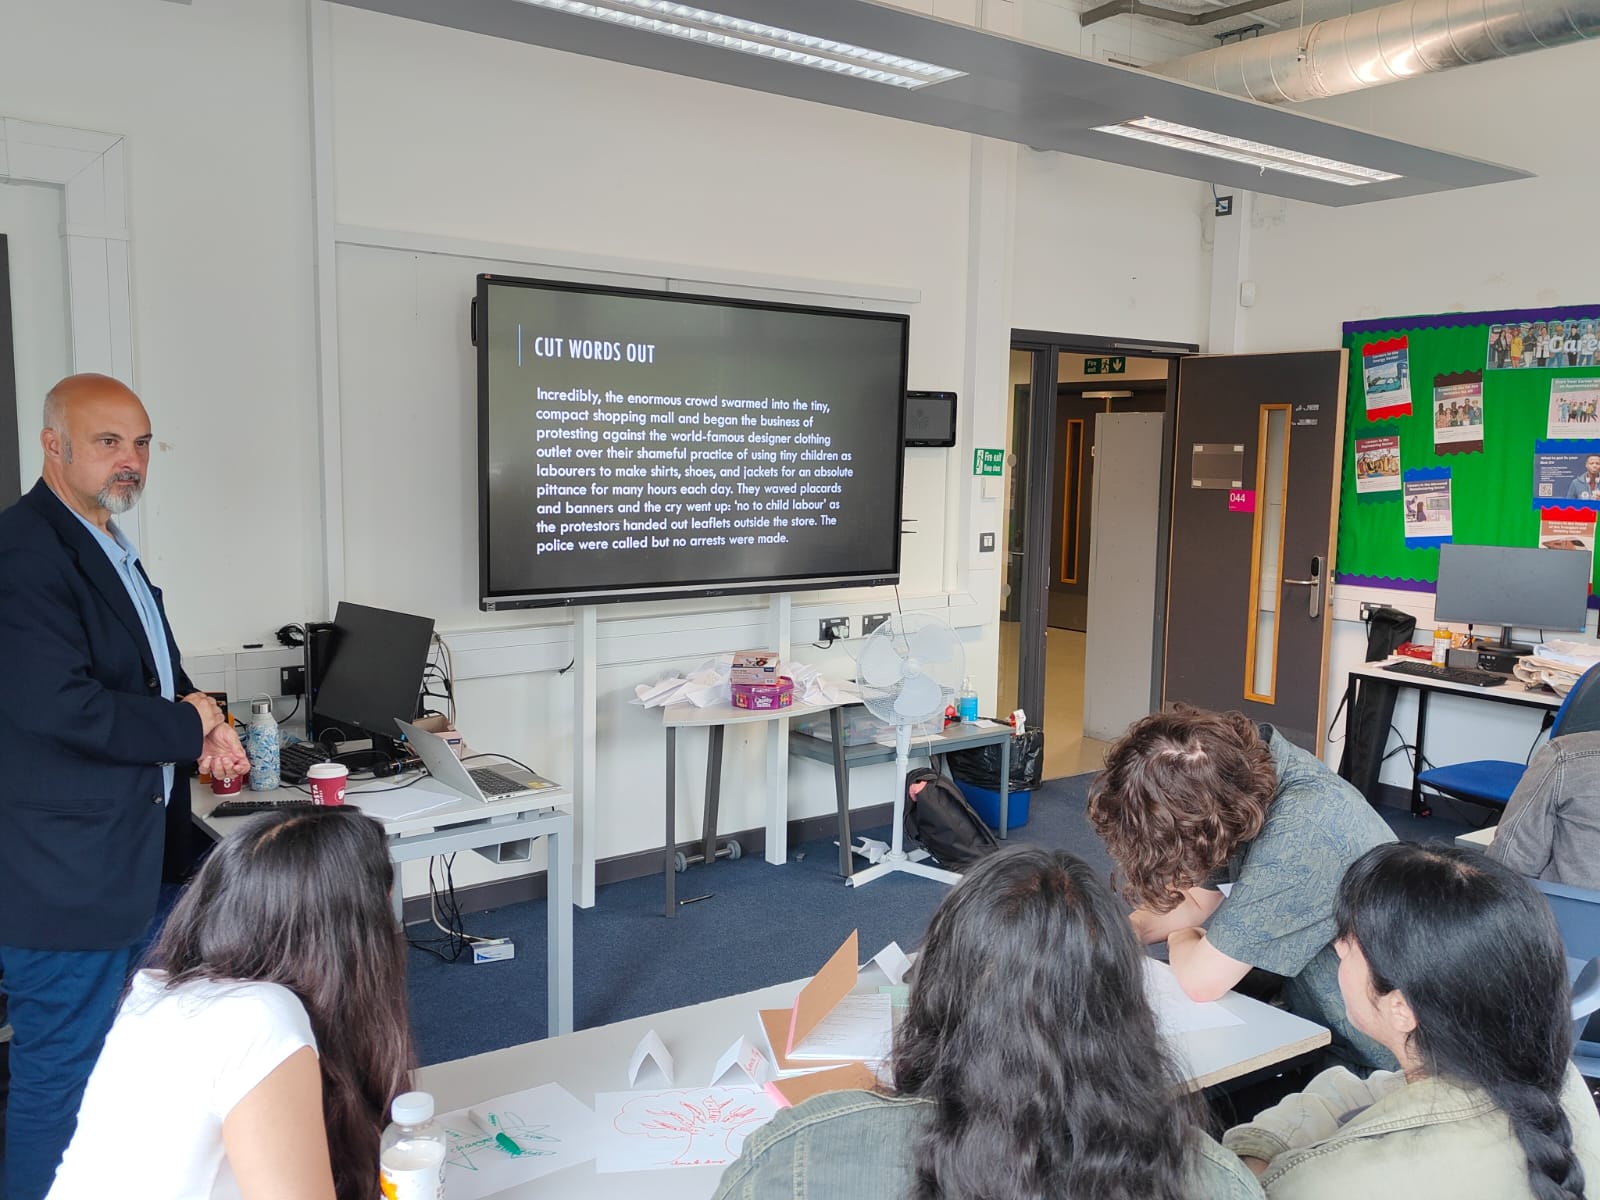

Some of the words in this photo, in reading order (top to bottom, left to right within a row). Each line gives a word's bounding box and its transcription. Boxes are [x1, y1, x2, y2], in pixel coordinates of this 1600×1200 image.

[535, 337, 564, 358] CUT
[568, 339, 621, 361] WORDS
[626, 343, 655, 363] OUT
[537, 387, 602, 406] Incredibly,
[605, 390, 624, 403] the
[627, 395, 682, 406] enormous
[684, 395, 718, 409] crowd
[721, 397, 768, 409] swarmed
[771, 398, 790, 410] into
[792, 398, 808, 410] the
[811, 400, 830, 414] tiny,
[536, 410, 590, 423] compact
[593, 408, 647, 426] shopping
[650, 411, 675, 424] mall
[677, 411, 700, 424] and
[703, 412, 738, 428] began
[740, 413, 758, 426] the
[760, 414, 800, 427] business
[802, 415, 814, 428] of
[536, 427, 599, 443] protesting
[602, 428, 646, 443] against
[649, 428, 667, 441] the
[670, 429, 745, 444] world-famous
[747, 431, 792, 446] designer
[793, 432, 831, 447] clothing
[536, 444, 573, 458] outlet
[575, 449, 603, 458] over
[606, 445, 634, 459] their
[637, 446, 687, 460] shameful
[690, 448, 734, 463] practice
[736, 448, 749, 460] of
[751, 449, 777, 463] using
[779, 449, 798, 464] tiny
[800, 448, 839, 461] children
[840, 453, 852, 461] as
[984, 451, 993, 461] Fire
[536, 463, 596, 477] labourers
[599, 466, 612, 477] to
[615, 464, 647, 477] make
[650, 464, 682, 480] shirts,
[684, 464, 717, 480] shoes,
[719, 465, 741, 477] and
[743, 465, 778, 480] jackets
[781, 465, 796, 477] for
[798, 468, 811, 478] an
[813, 465, 854, 478] absolute
[536, 483, 587, 499] pittance
[590, 482, 609, 496] for
[612, 486, 644, 498] many
[647, 482, 677, 495] hours
[680, 482, 707, 495] each
[710, 482, 734, 497] day.
[736, 482, 761, 497] They
[764, 481, 797, 494] waved
[799, 482, 842, 497] placards
[1230, 493, 1246, 503] 044
[536, 501, 562, 515] and
[565, 501, 614, 514] banners
[617, 500, 641, 513] and
[643, 500, 662, 513] the
[664, 503, 683, 517] cry
[685, 501, 712, 512] went
[714, 502, 732, 515] up:
[752, 500, 763, 511] to
[765, 498, 790, 511] child
[829, 501, 840, 510] as
[536, 520, 557, 533] the
[560, 520, 621, 536] protestors
[623, 517, 668, 531] handed
[670, 519, 688, 530] out
[691, 516, 731, 529] leaflets
[733, 515, 771, 528] outside
[772, 515, 789, 527] the
[791, 516, 818, 527] store.
[820, 514, 837, 526] The
[536, 538, 575, 555] police
[578, 540, 609, 550] were
[611, 535, 648, 549] called
[651, 535, 670, 548] but
[672, 537, 687, 547] no
[689, 535, 726, 547] arrests
[729, 536, 755, 545] were
[757, 531, 789, 544] made.
[312, 784, 321, 805] OSTA
